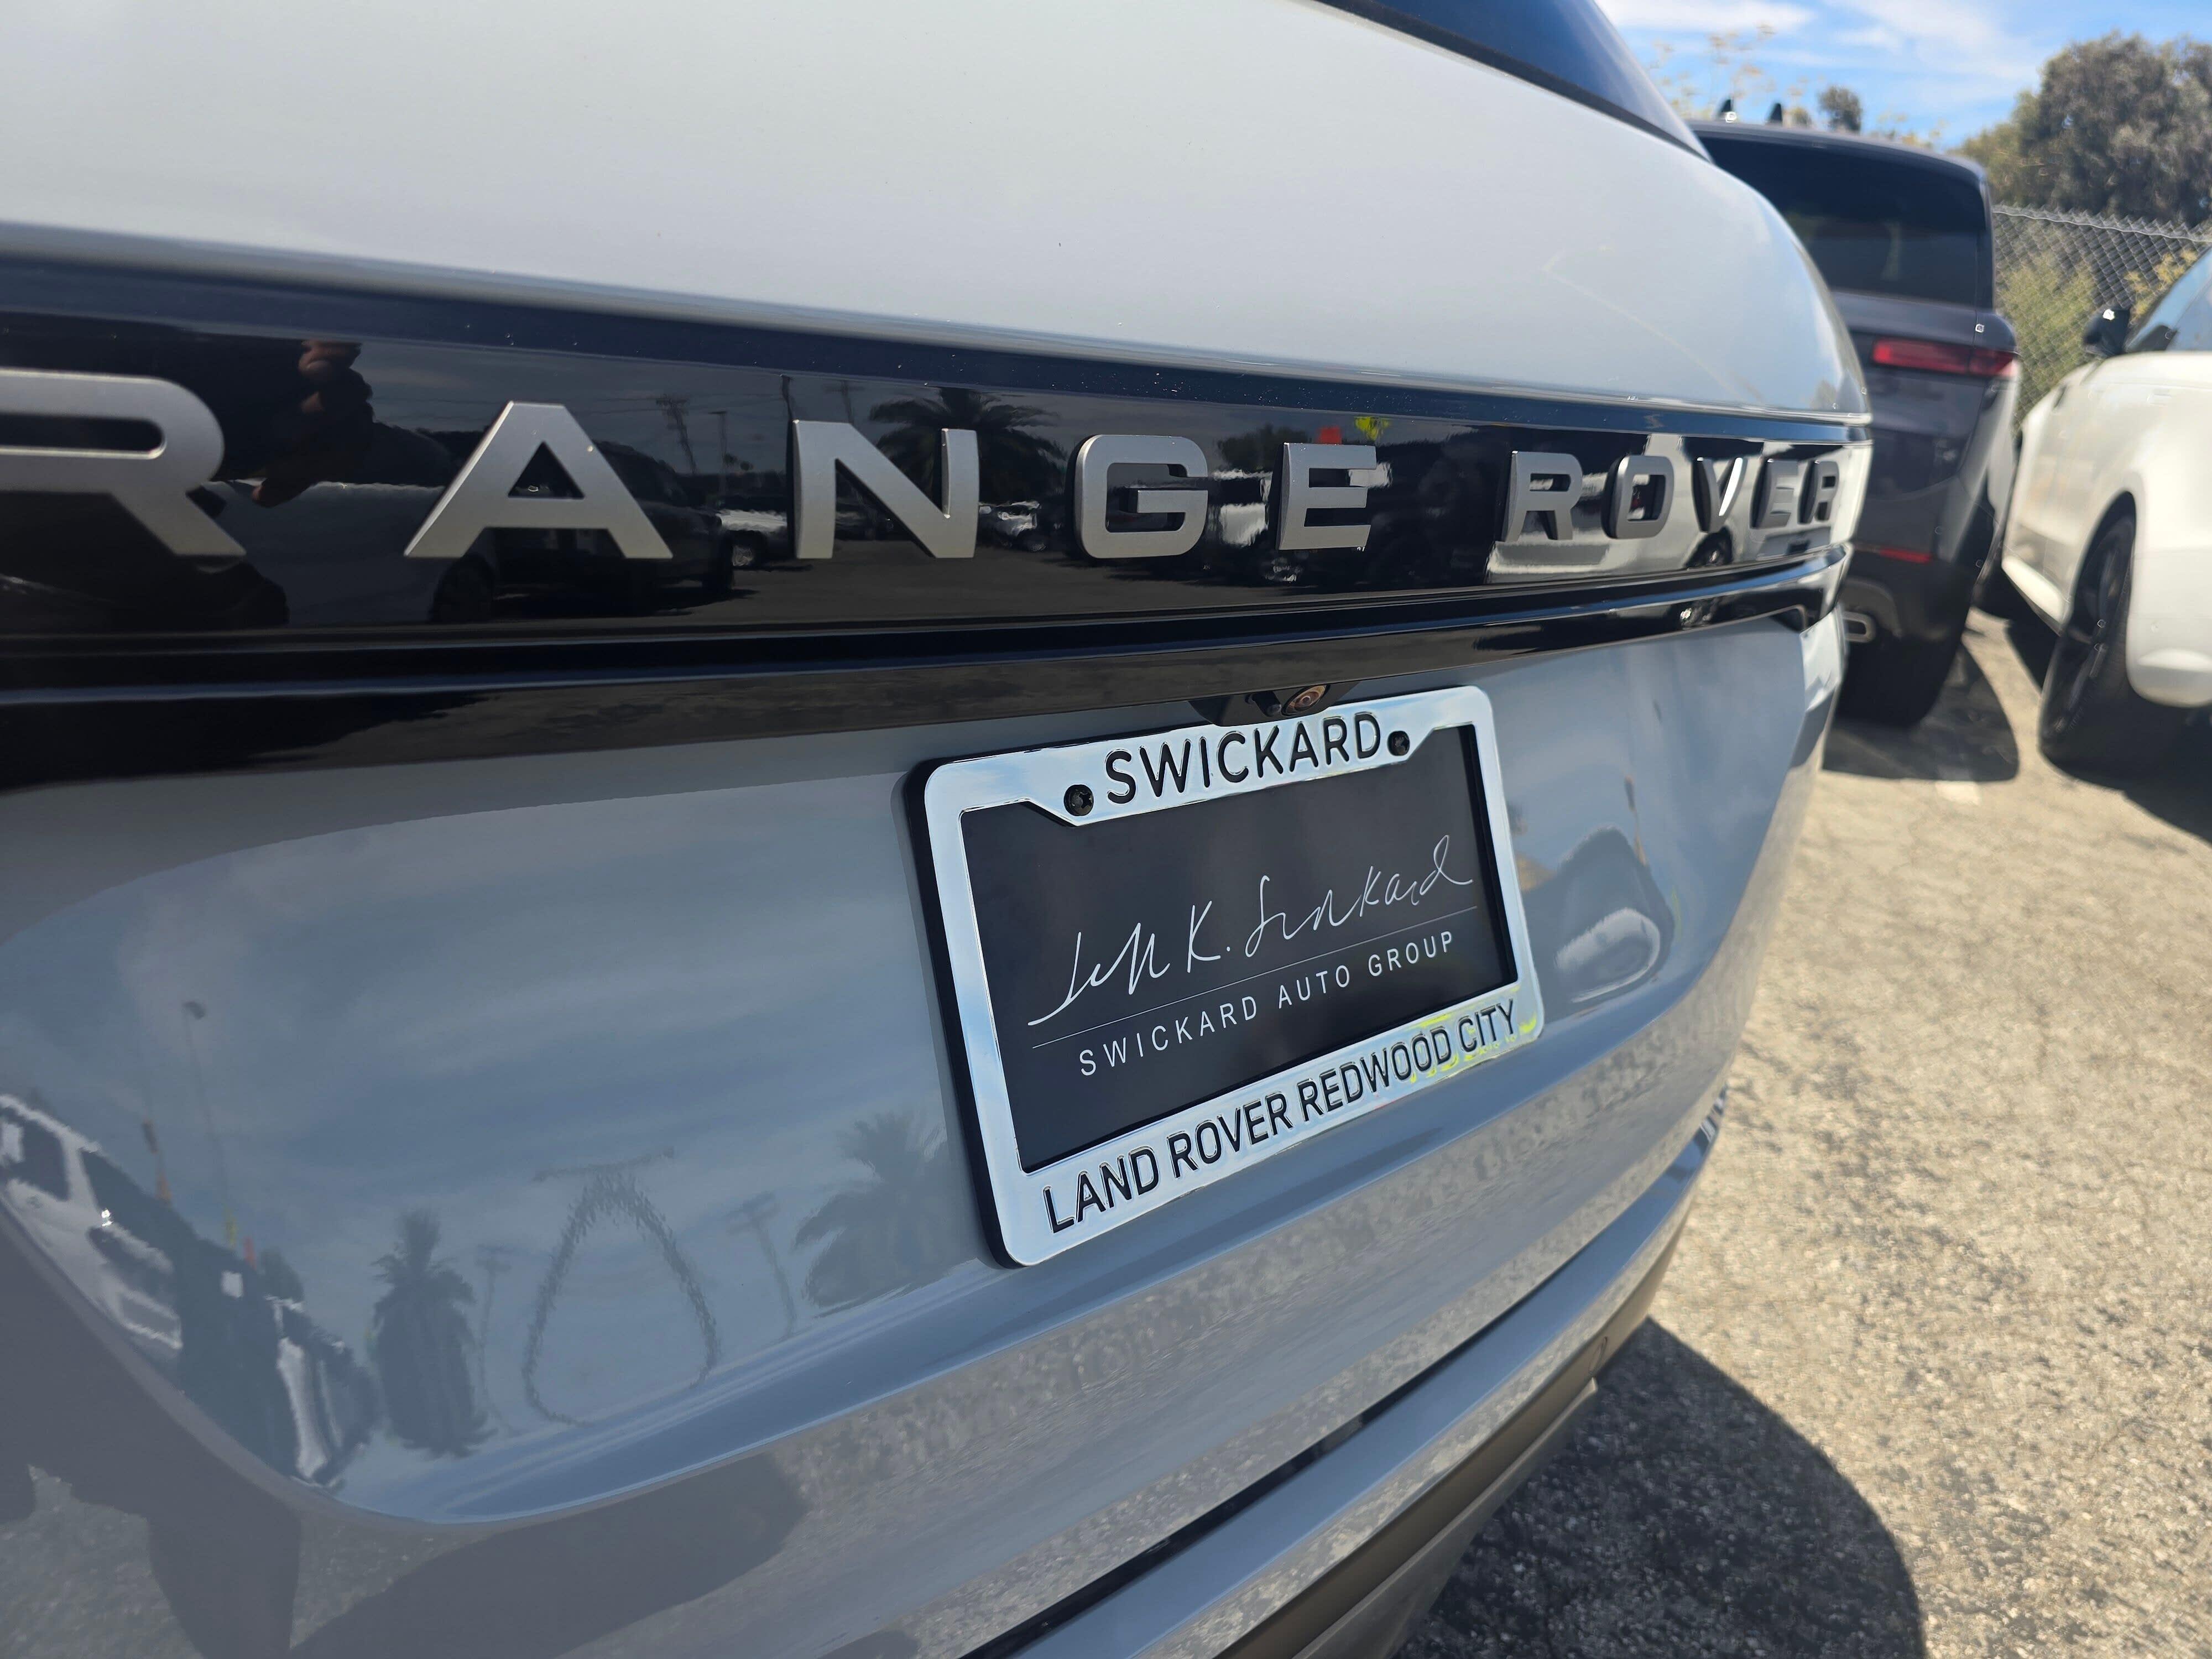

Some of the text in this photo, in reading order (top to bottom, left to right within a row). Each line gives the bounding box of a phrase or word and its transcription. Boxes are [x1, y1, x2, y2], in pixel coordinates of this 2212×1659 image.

[0, 368, 1839, 559] RANGE ROVER
[1105, 711, 1380, 805] SWICKARD
[1079, 930, 1455, 1077] SWICKARD AUTO GROUP
[1044, 998, 1519, 1234] LAND ROVER REDWOOD CITY
